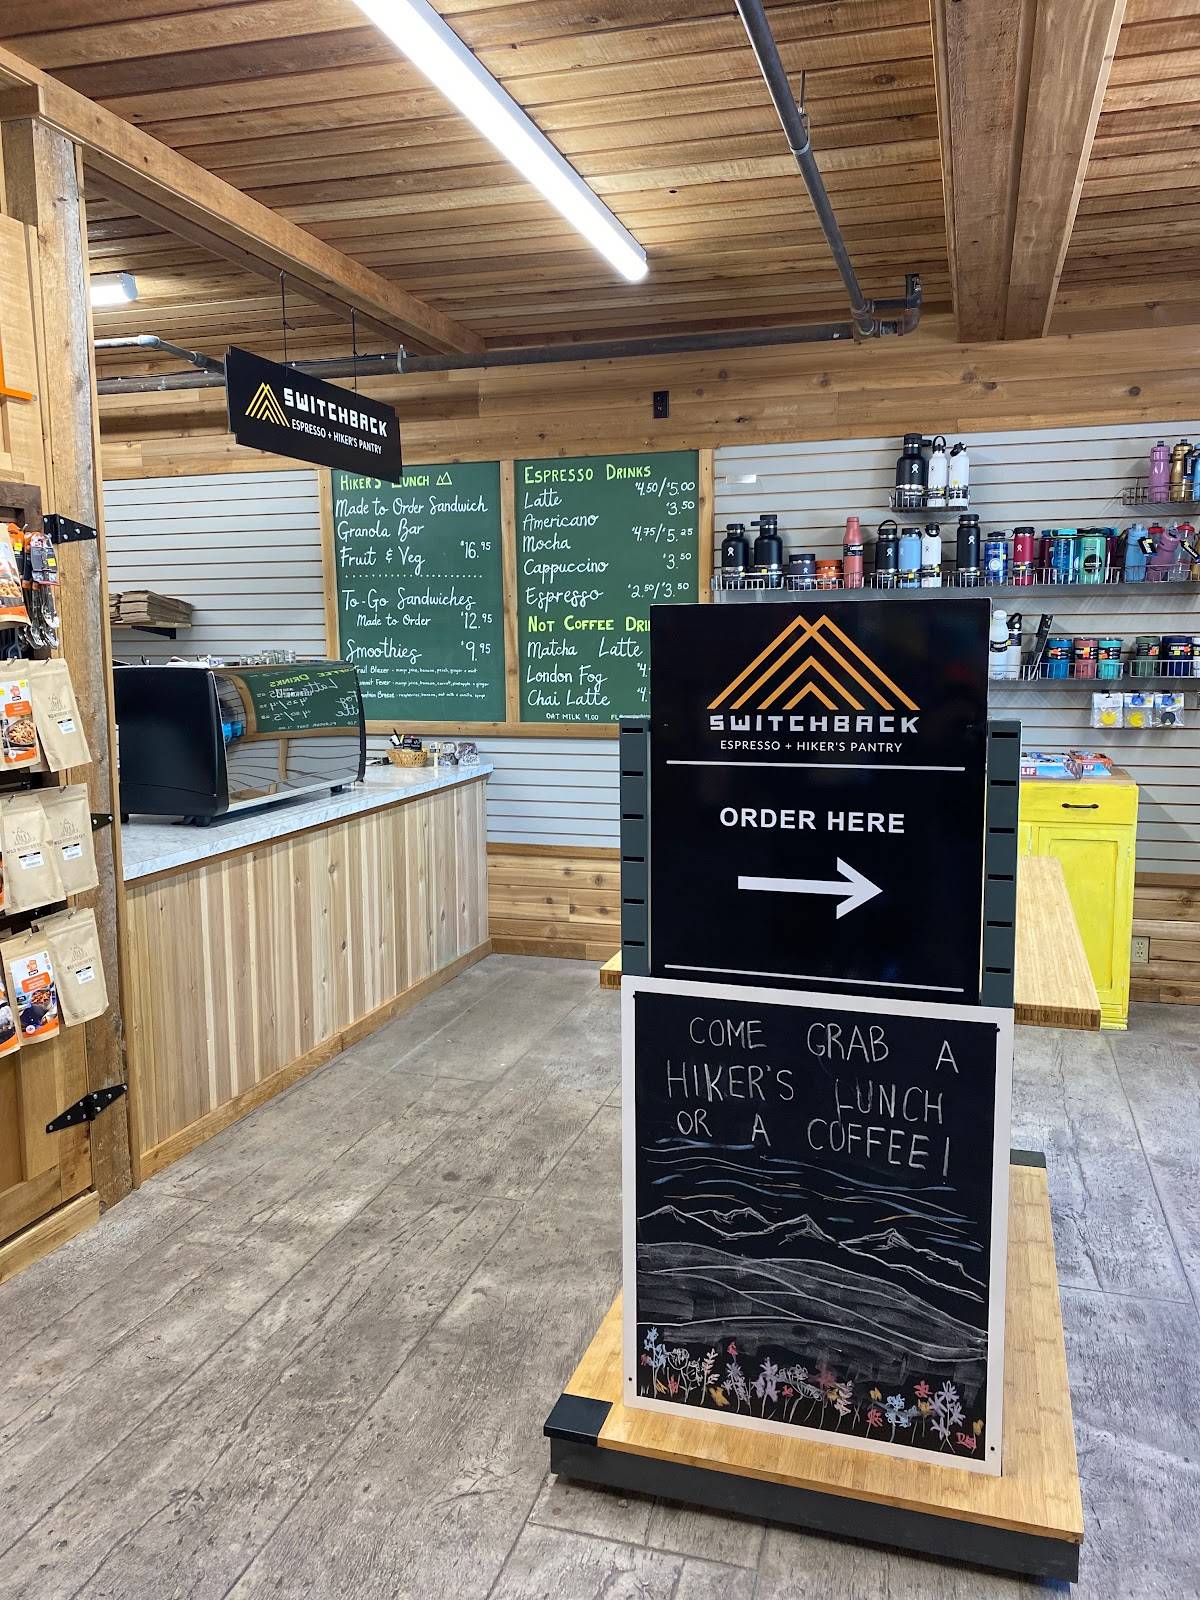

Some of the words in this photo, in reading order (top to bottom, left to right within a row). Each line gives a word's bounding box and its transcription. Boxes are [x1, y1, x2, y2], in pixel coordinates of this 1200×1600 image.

[283, 387, 388, 438] SWITCHBACK
[291, 418, 326, 438] ESPRESSO
[327, 431, 332, 439] +
[333, 431, 358, 448] HIKER'S
[358, 439, 382, 455] PANTRY
[524, 465, 594, 484] ESPRESSO
[606, 463, 651, 481] DRINKS
[335, 497, 369, 518] Made
[372, 497, 389, 516] to
[392, 497, 424, 515] Order
[429, 495, 488, 515] Sandwich
[524, 487, 562, 509] Latte
[337, 520, 390, 542] Granola
[398, 518, 424, 542] Bar
[522, 513, 599, 531] Americano
[460, 541, 491, 559] $16.95
[522, 532, 571, 552] Mocha
[340, 546, 377, 567] Fruit
[398, 546, 425, 576] Veg
[523, 557, 609, 584] Cappuccino
[342, 588, 389, 612] To-Go
[397, 586, 476, 610] Sandwiches
[525, 586, 604, 613] Espresso
[357, 613, 382, 627] Made
[385, 614, 399, 626] to
[402, 613, 431, 626] Order
[460, 611, 493, 629] $12.95
[528, 615, 556, 632] NOT
[563, 615, 614, 631] COFFEE
[345, 636, 422, 664] Smoothies
[460, 640, 491, 662] $9.95
[527, 638, 577, 659] Matcha
[599, 636, 643, 657] Latte
[526, 664, 572, 683] London
[579, 664, 608, 692] Fog
[527, 689, 560, 706] Chai
[566, 687, 610, 706] Latte
[545, 712, 560, 720] OAT
[709, 714, 920, 734] SWITCHBACK
[720, 740, 780, 751] ESPRESSO
[796, 741, 846, 752] HIKER'S
[850, 741, 903, 753] PANTRY
[1021, 767, 1036, 775] LIF
[720, 807, 816, 830] ORDER
[827, 811, 905, 834] HERE
[689, 1017, 767, 1049] COME
[807, 1022, 889, 1063] GRAB
[935, 1039, 960, 1074] A
[666, 1059, 795, 1102] HIKER'S
[834, 1078, 943, 1125] LUNCH
[676, 1108, 713, 1138] OR
[750, 1112, 772, 1147] A
